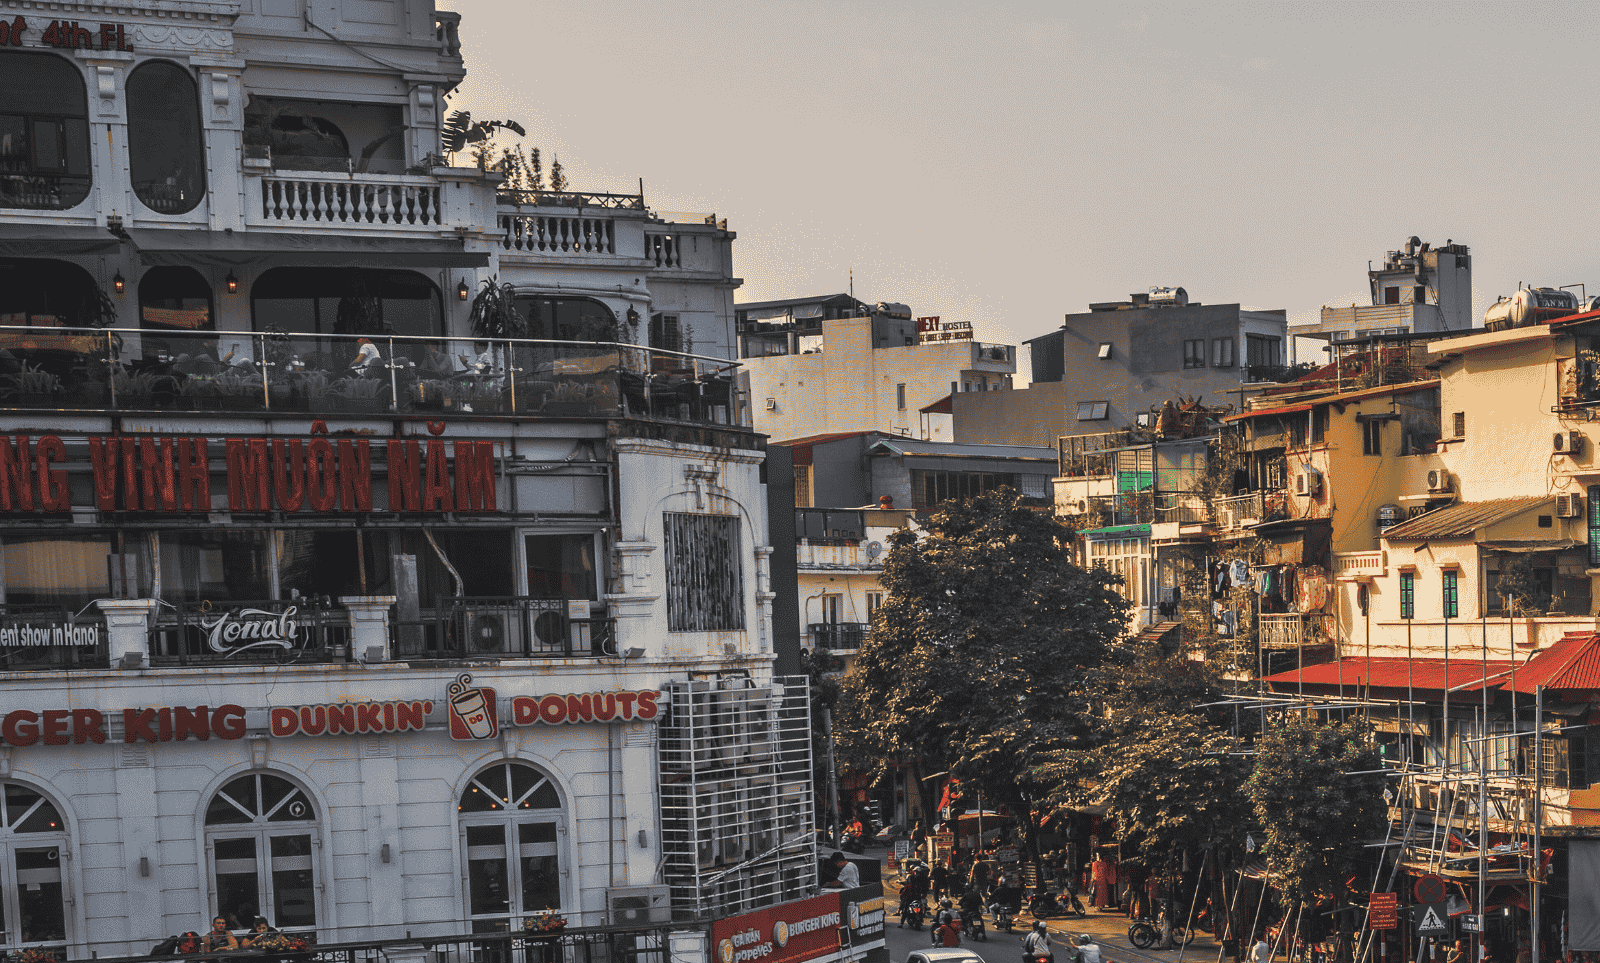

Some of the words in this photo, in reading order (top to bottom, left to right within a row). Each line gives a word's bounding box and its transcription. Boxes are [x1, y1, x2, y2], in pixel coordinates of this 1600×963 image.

[42, 20, 92, 49] 4th
[88, 436, 212, 513] VINH
[225, 419, 373, 513] MUÔN
[387, 421, 497, 513] NĂM
[21, 623, 50, 646] show
[52, 623, 63, 646] in
[64, 623, 99, 646] Hanoi
[270, 700, 434, 738] DUNKIN'
[512, 691, 661, 725] DONUTS
[2, 708, 106, 747] GER
[124, 704, 247, 744] KING
[788, 916, 820, 937] BURGER
[821, 911, 841, 929] KING
